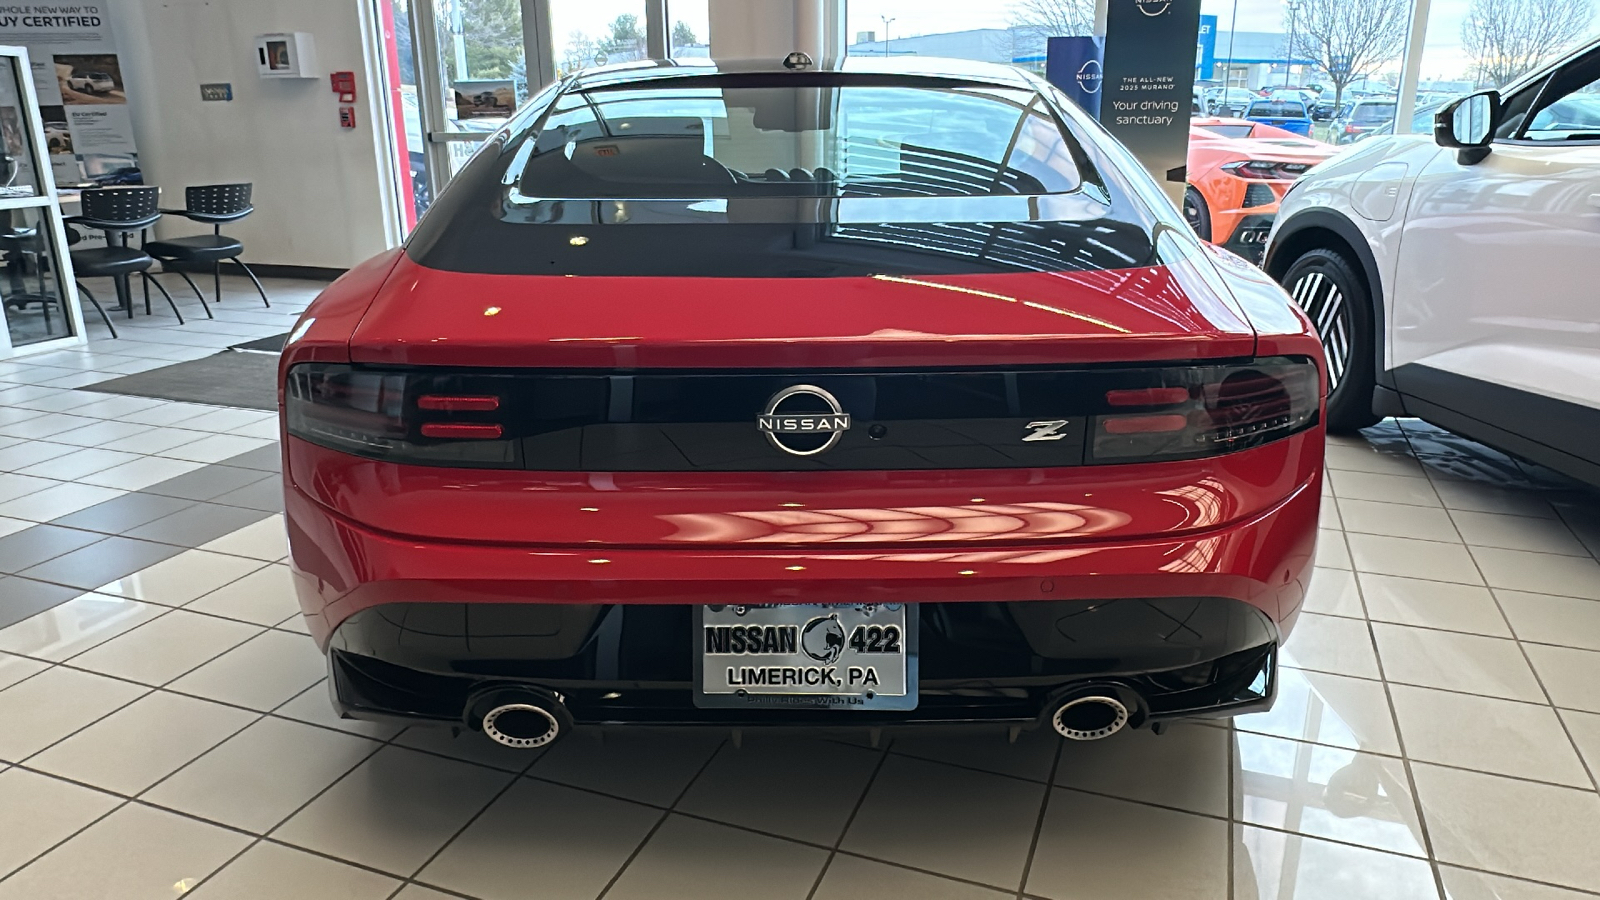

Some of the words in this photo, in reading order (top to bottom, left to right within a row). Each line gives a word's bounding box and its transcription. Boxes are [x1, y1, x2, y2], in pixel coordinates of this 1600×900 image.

[34, 6, 57, 14] NEW
[59, 6, 81, 14] WAY
[83, 6, 98, 14] TO
[23, 16, 101, 27] CERTIFIED
[1113, 101, 1138, 110] Your
[1140, 100, 1179, 113] driving
[1116, 116, 1173, 126] sanctuary
[758, 417, 849, 431] NISSAN
[1022, 420, 1069, 442] Z
[704, 625, 799, 654] NISSAN
[849, 625, 901, 654] 422
[727, 667, 842, 687] LIMERICK,
[849, 668, 879, 685] PA
[817, 696, 845, 706] With
[848, 696, 864, 706] Us
